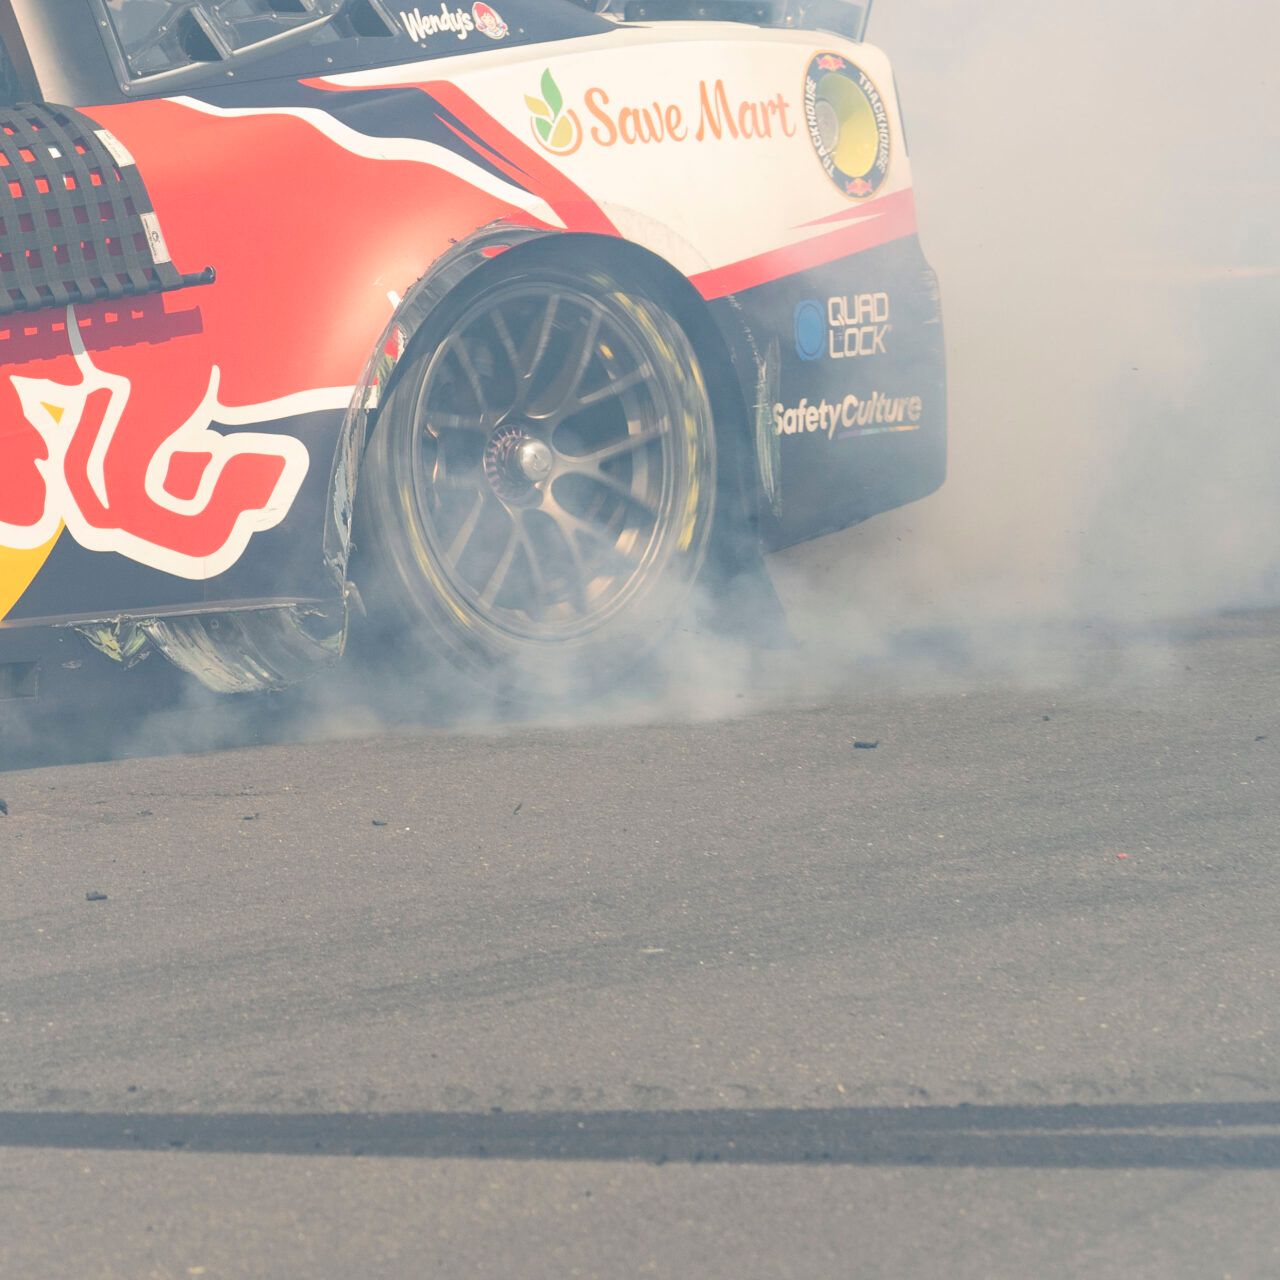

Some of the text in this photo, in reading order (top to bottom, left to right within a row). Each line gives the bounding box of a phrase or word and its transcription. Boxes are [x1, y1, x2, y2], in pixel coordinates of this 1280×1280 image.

[400, 3, 474, 42] Wendy's
[584, 78, 796, 146] Save Mart
[858, 72, 890, 174] TRACKHOUSE
[827, 292, 889, 327] QUAD
[829, 326, 888, 359] LOCK
[772, 391, 923, 440] SafetyCulture
